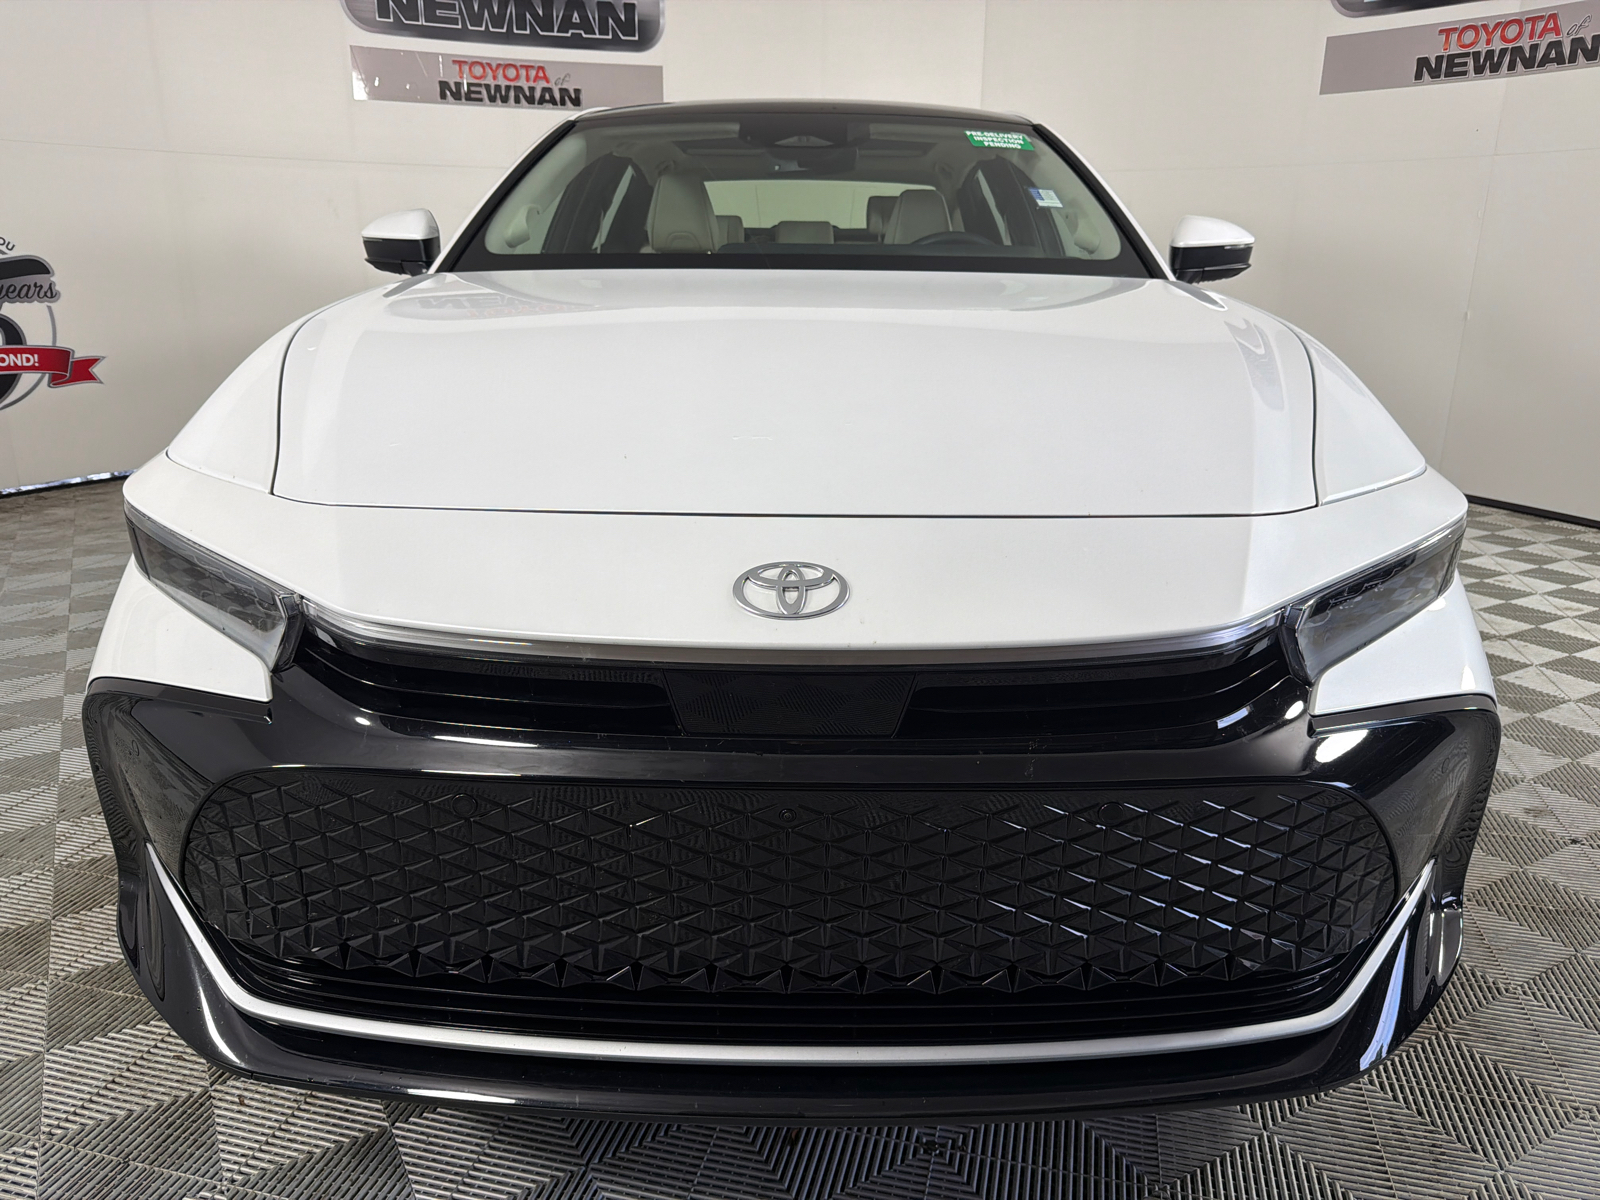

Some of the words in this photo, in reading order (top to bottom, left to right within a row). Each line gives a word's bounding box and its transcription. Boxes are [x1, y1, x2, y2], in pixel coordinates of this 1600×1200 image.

[375, 0, 639, 40] NEWNAN
[1438, 12, 1563, 51] TOYOTA
[1566, 14, 1592, 37] of
[1413, 34, 1600, 83] NEWNAN
[452, 59, 550, 84] TOYOTA
[554, 73, 571, 87] of
[438, 80, 582, 107] NEWNAN
[965, 130, 1023, 139] PRE-DELIVERY
[973, 136, 1024, 144] INSPECTION
[983, 141, 1021, 149] PENDING
